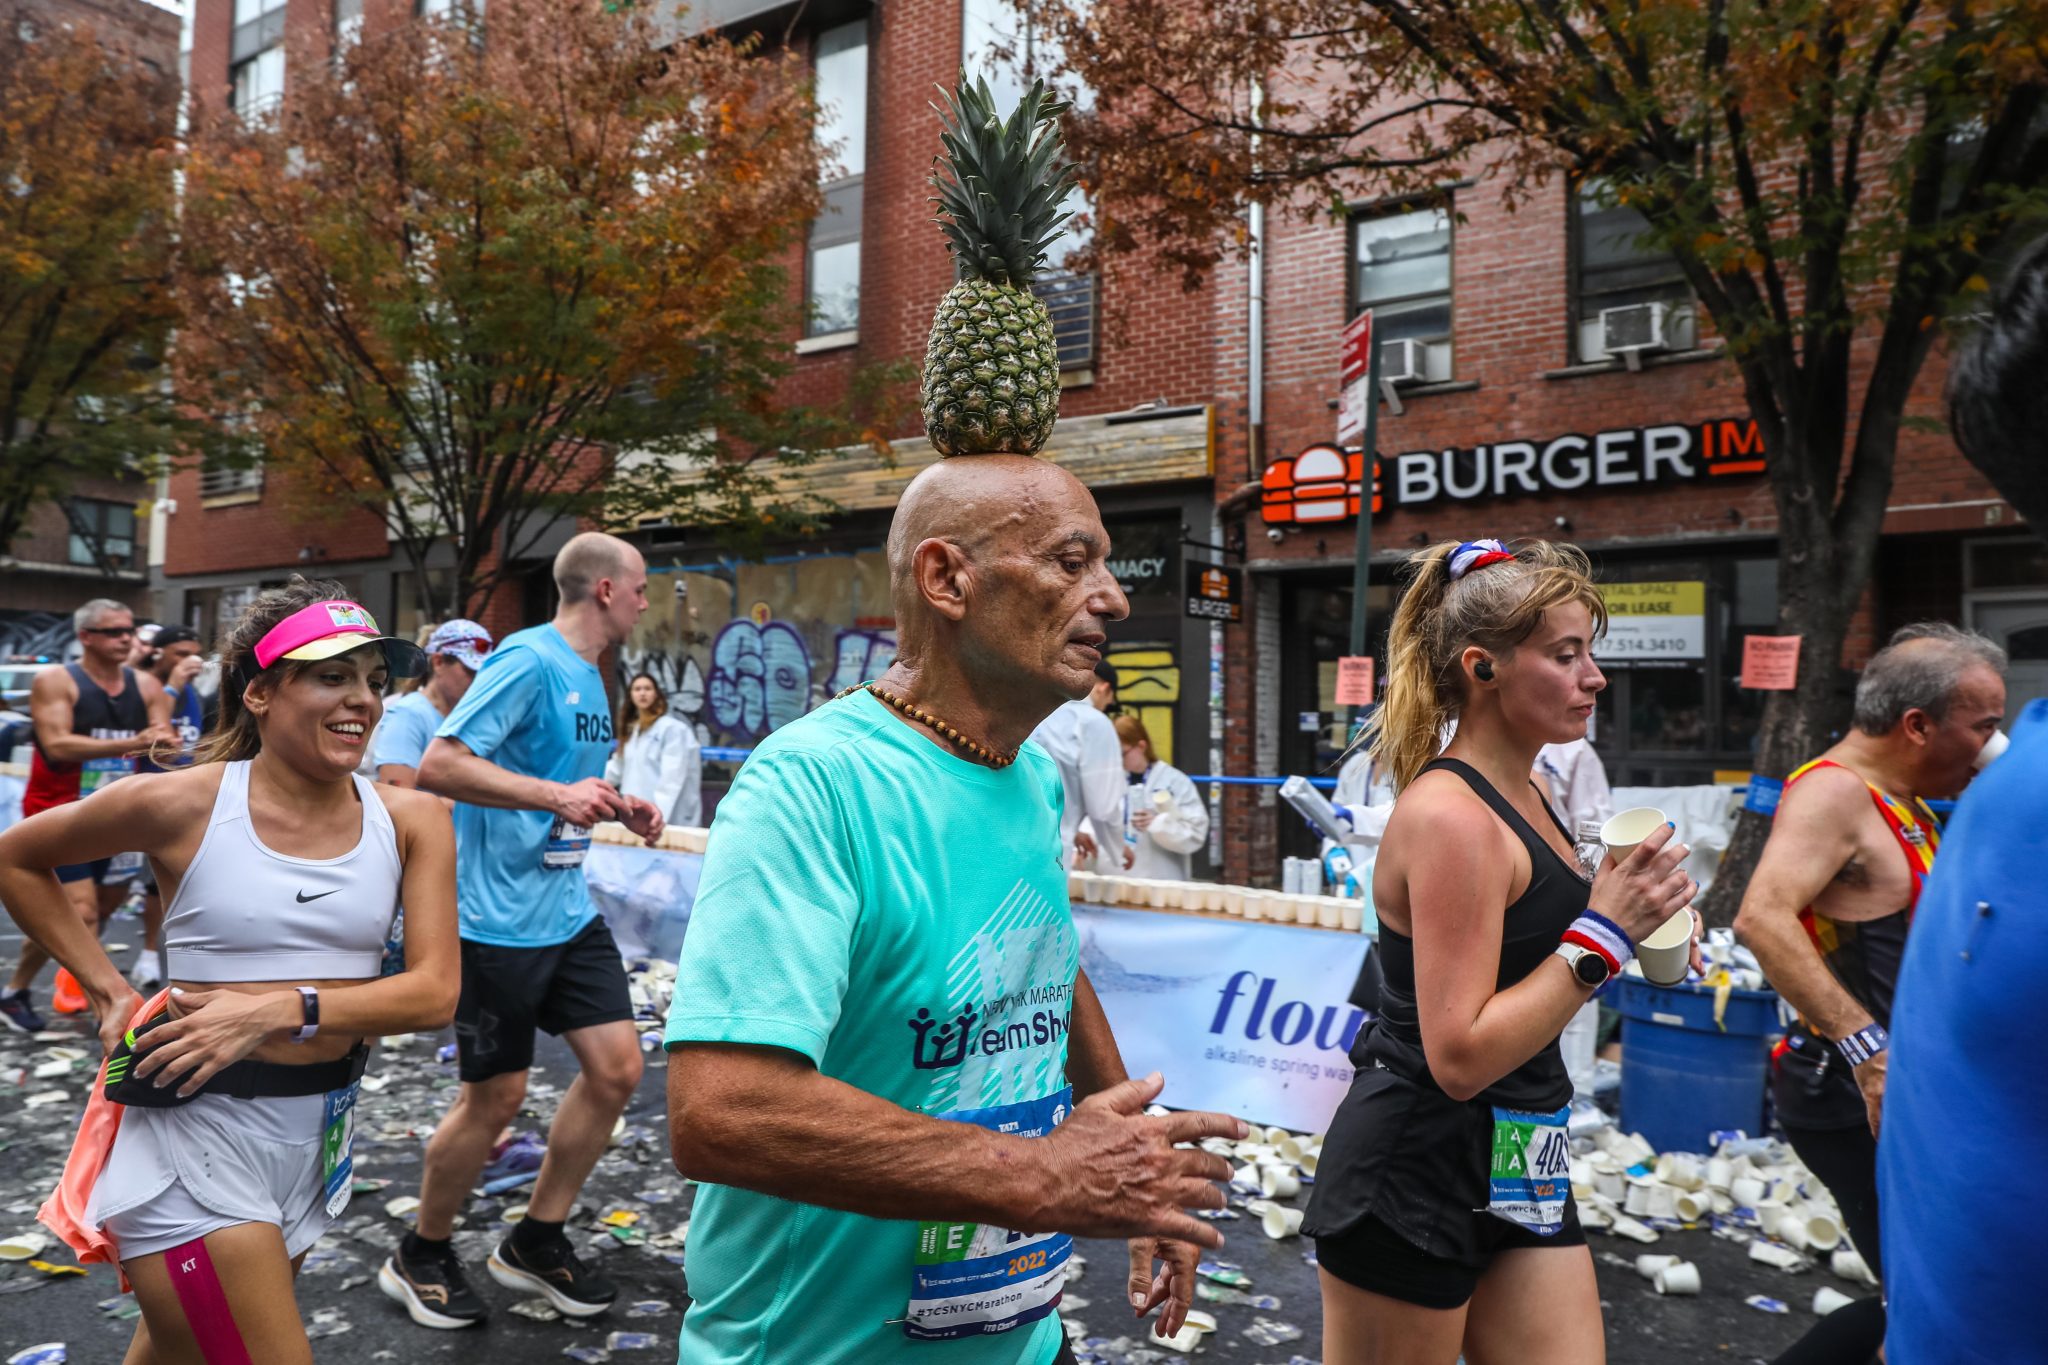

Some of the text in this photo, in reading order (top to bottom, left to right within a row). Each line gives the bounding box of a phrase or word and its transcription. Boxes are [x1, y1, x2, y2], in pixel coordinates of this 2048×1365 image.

[1106, 558, 1166, 578] MACY
[1602, 583, 1677, 596] ETAIL SPACE
[1607, 601, 1673, 614] OR LEASE
[1594, 638, 1687, 652] 17.514.3410
[575, 712, 611, 743] ROS
[1204, 1045, 1267, 1068] alkaline
[1271, 1058, 1320, 1080] spring
[998, 1121, 1020, 1133] TATA
[1507, 1153, 1522, 1171] A
[947, 1225, 965, 1250] E
[181, 1257, 197, 1274] KT
[1007, 1249, 1047, 1277] 2022
